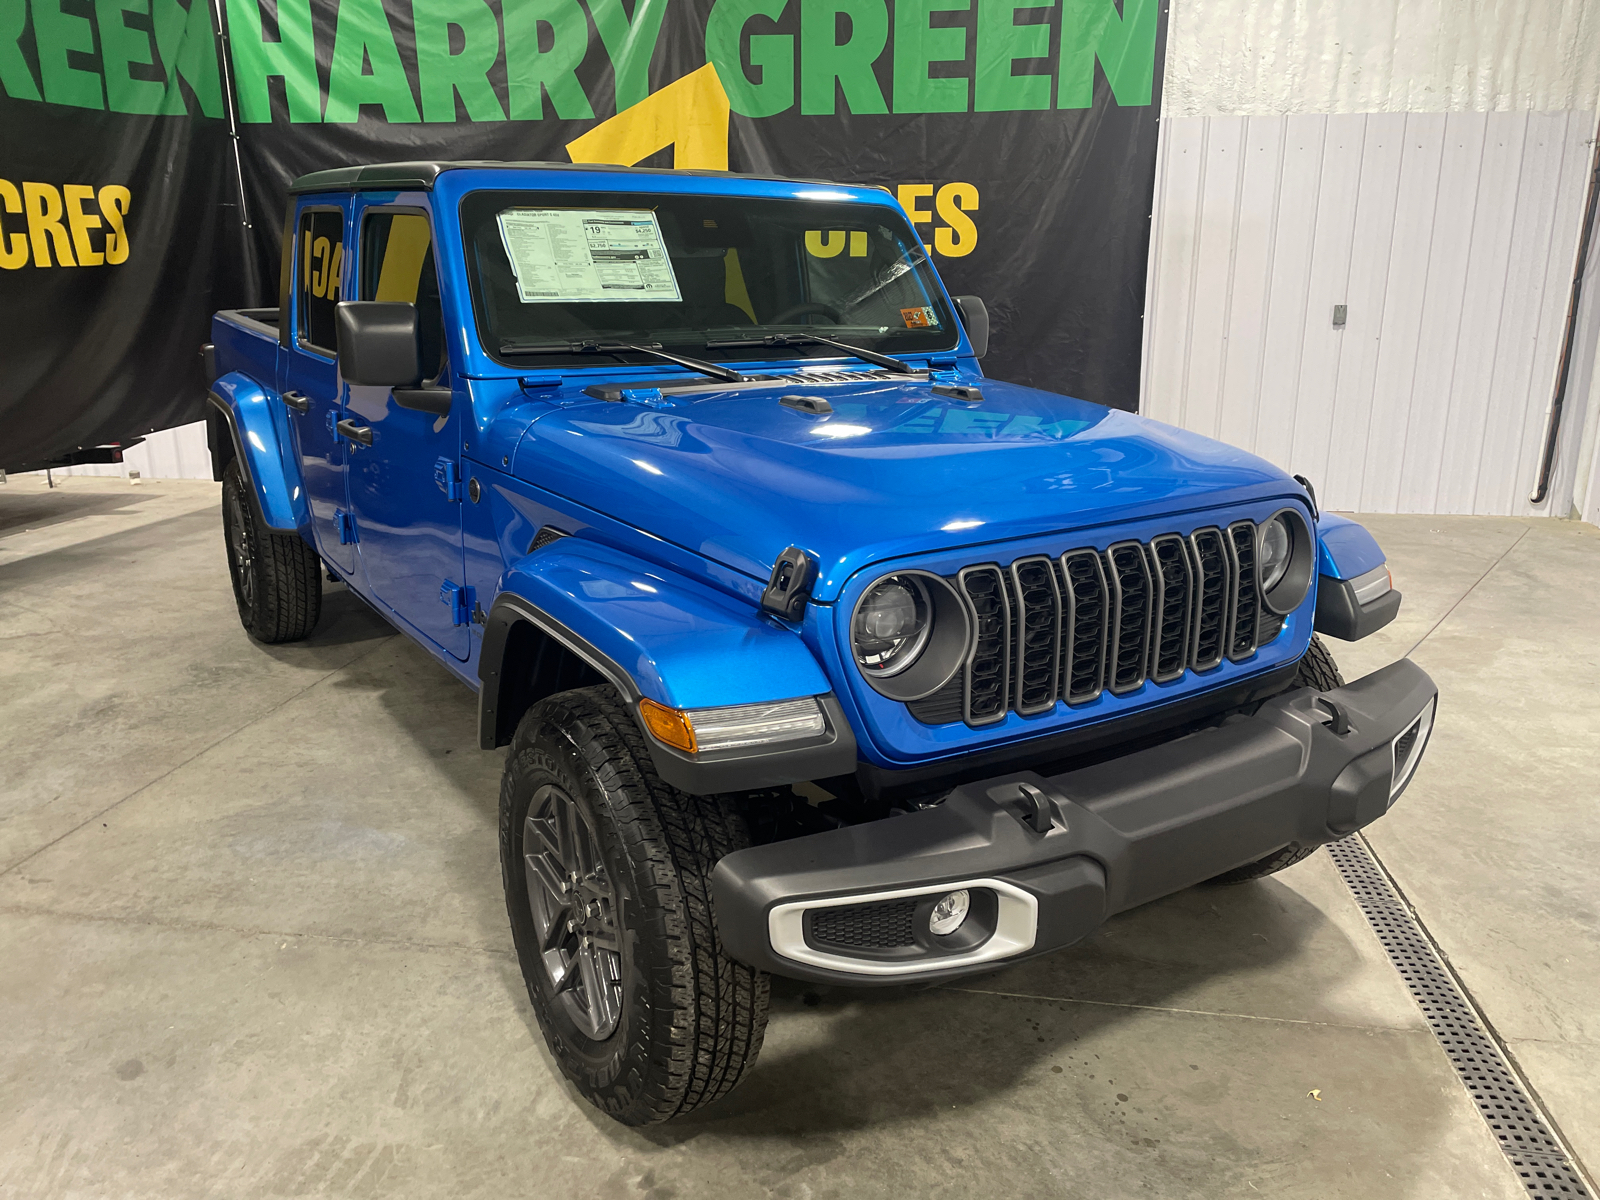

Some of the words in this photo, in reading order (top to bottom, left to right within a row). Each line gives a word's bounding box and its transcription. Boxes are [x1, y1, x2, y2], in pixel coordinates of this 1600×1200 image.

[226, 0, 669, 124] HARRY
[705, 0, 1158, 118] GREEN
[590, 226, 601, 234] 19
